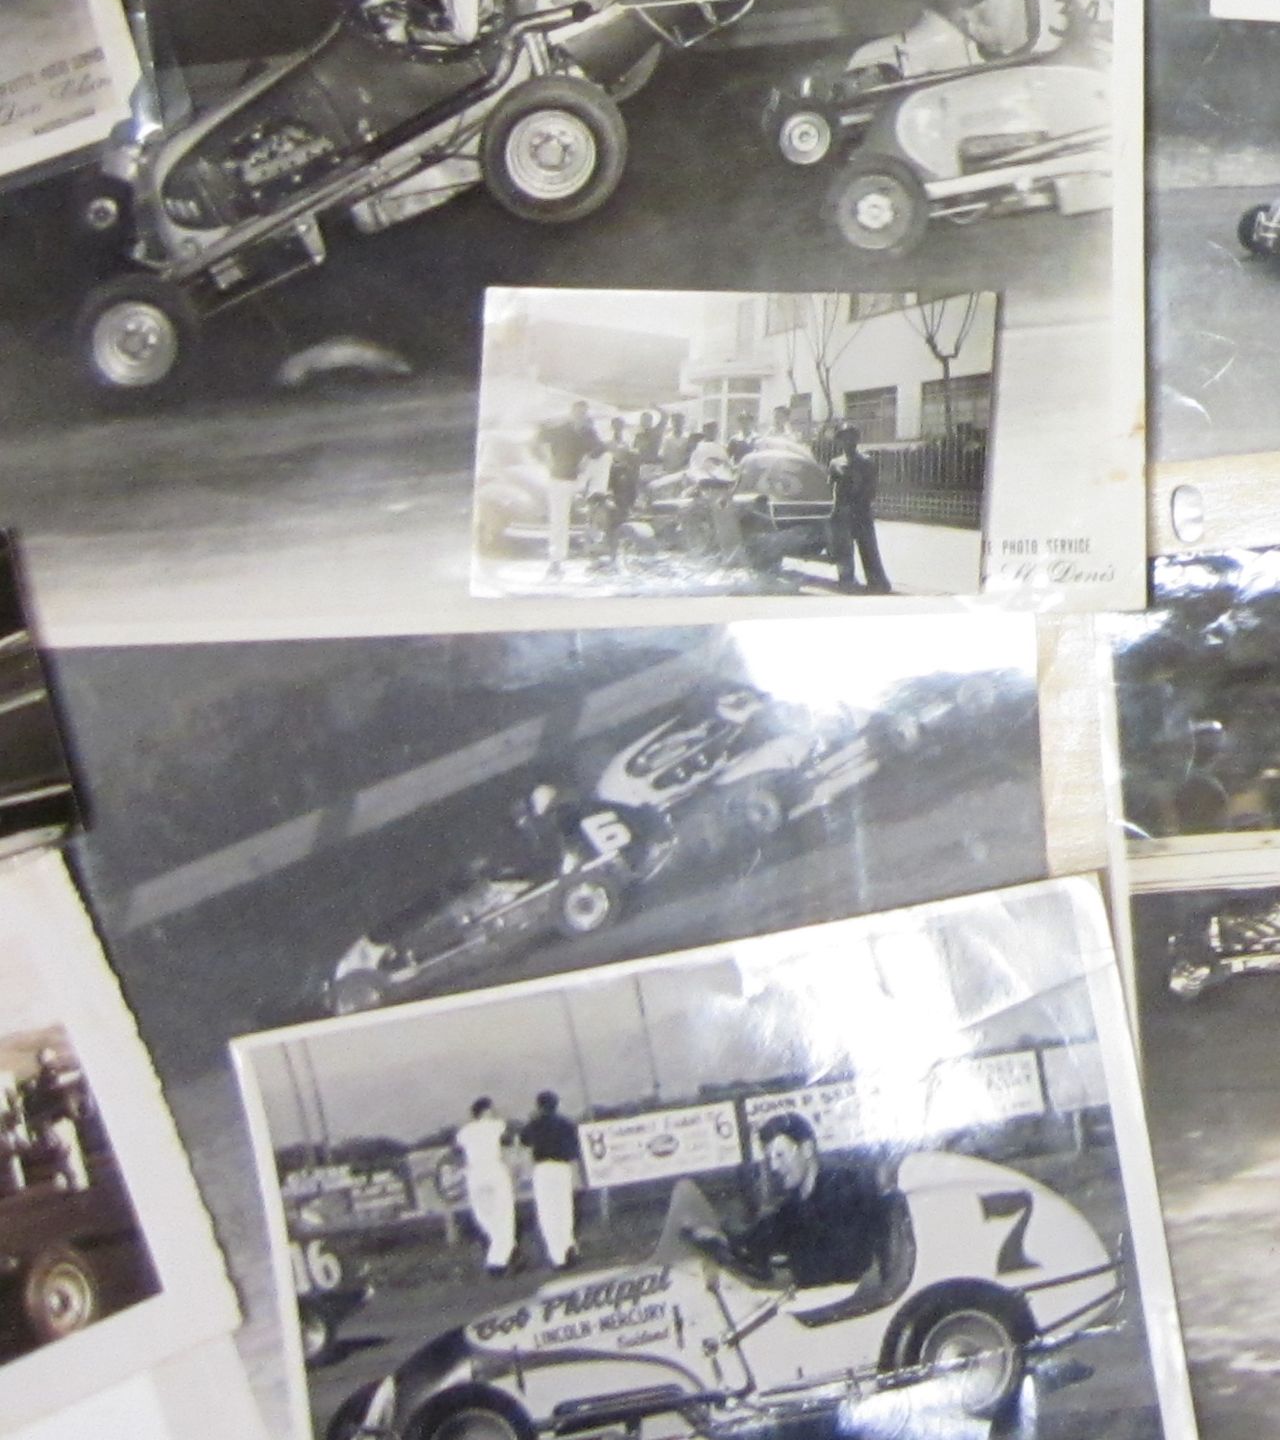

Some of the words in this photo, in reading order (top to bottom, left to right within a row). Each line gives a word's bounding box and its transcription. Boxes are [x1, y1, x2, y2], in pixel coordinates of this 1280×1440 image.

[1002, 538, 1039, 555] PHOTO
[1046, 537, 1091, 555] SERVICE
[979, 1188, 1043, 1275] 7
[290, 1239, 343, 1295] 16
